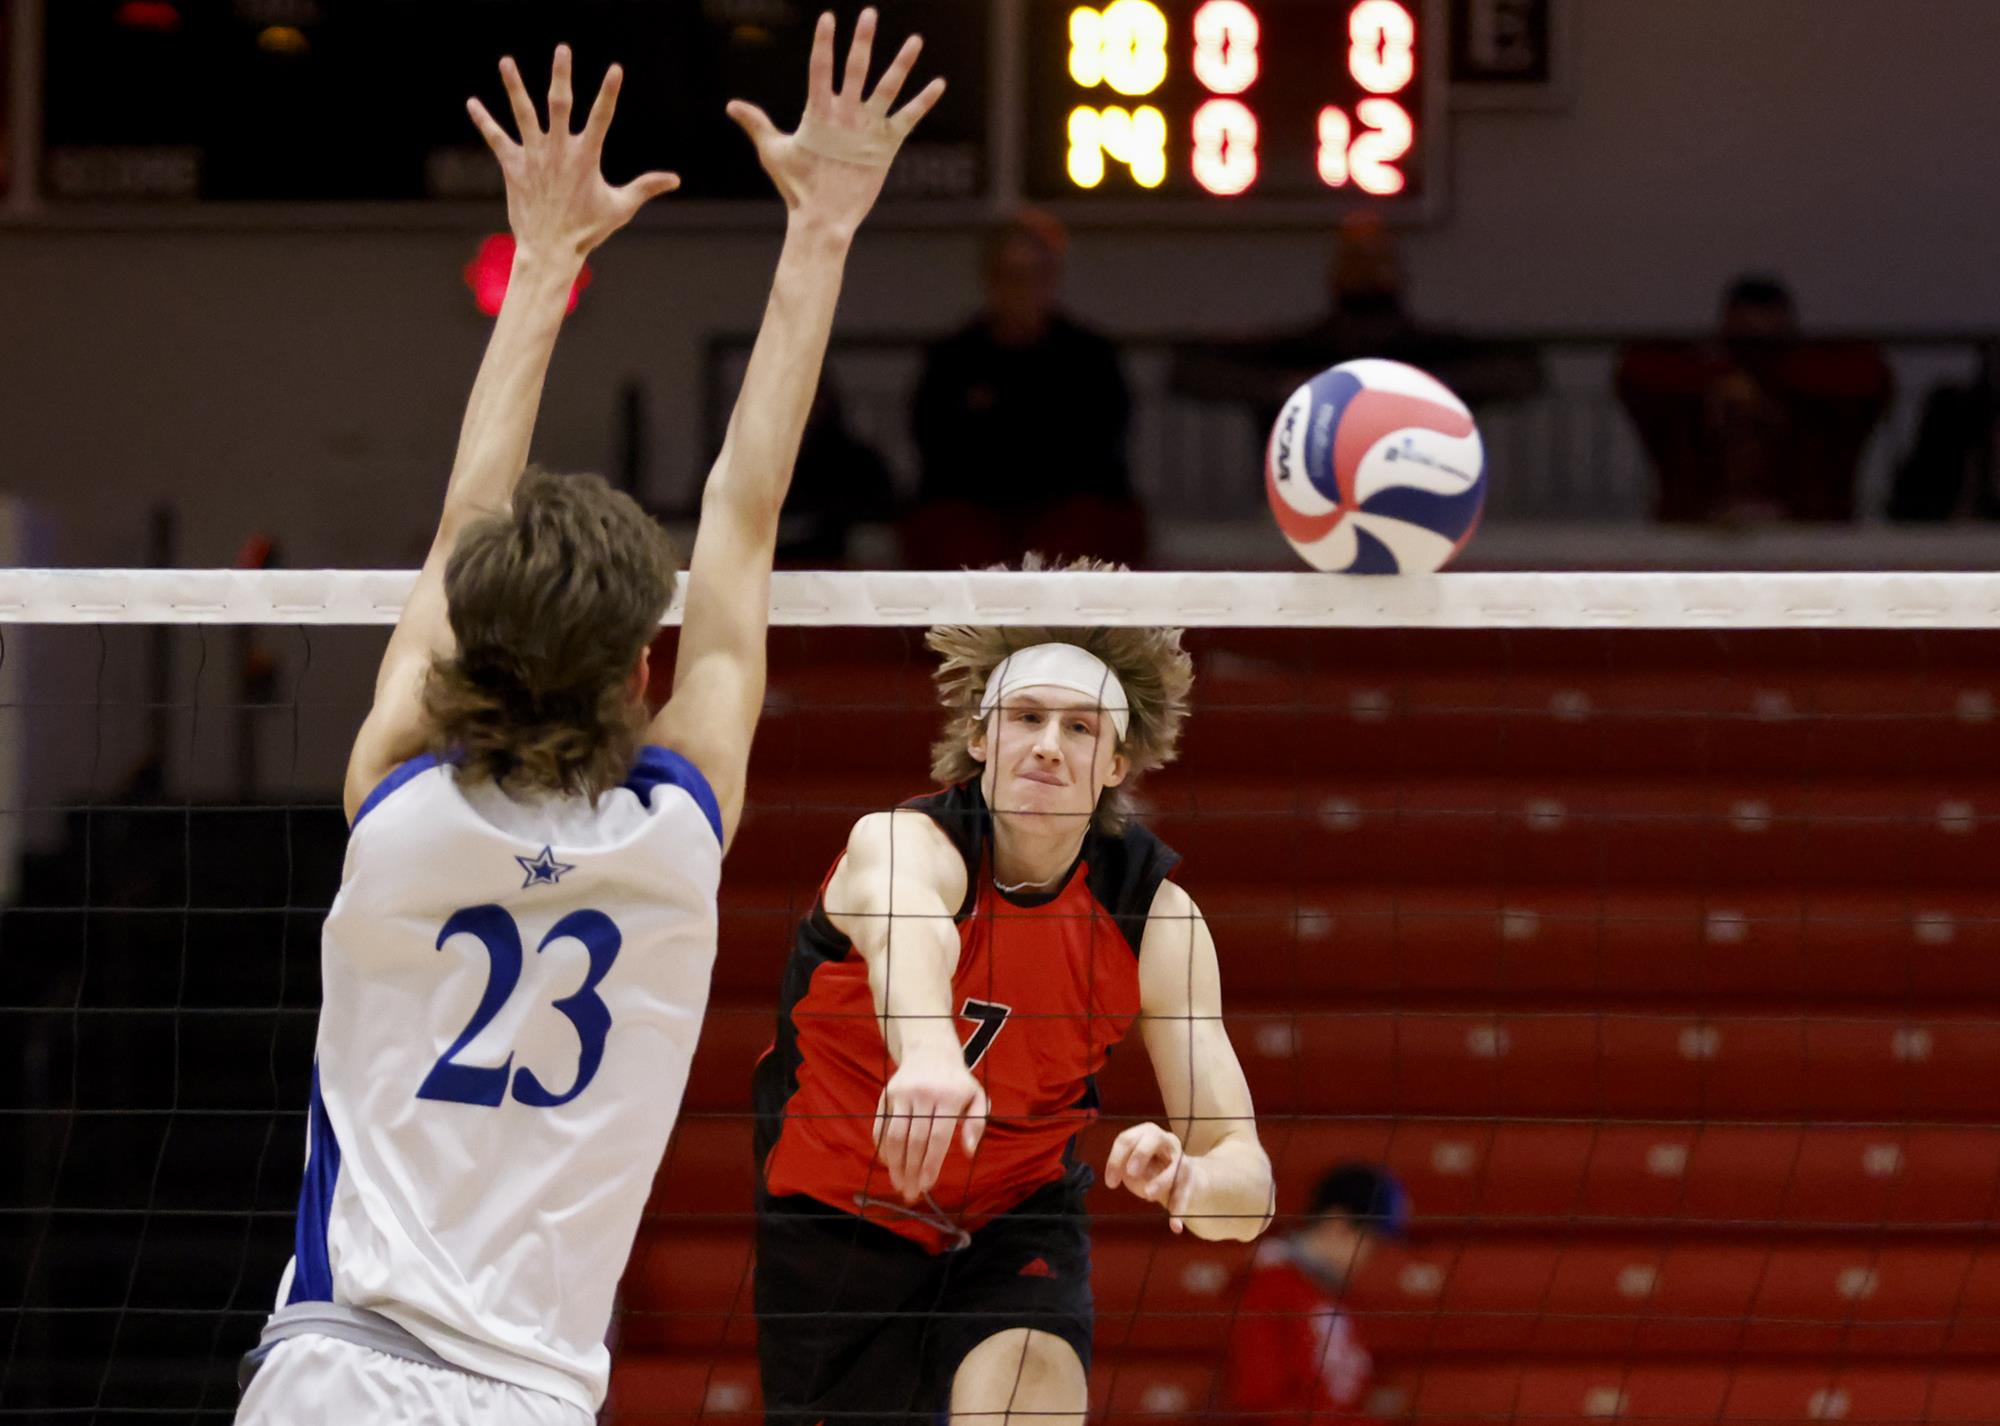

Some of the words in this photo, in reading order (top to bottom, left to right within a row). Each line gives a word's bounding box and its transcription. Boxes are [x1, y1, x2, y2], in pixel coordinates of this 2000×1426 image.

[1193, 0, 1259, 94] 0
[1348, 0, 1414, 94] 0
[1067, 105, 1167, 189] 14
[1192, 99, 1258, 196] 0
[1317, 99, 1413, 195] 12
[415, 903, 623, 1108] 23
[960, 997, 1013, 1072] 7
